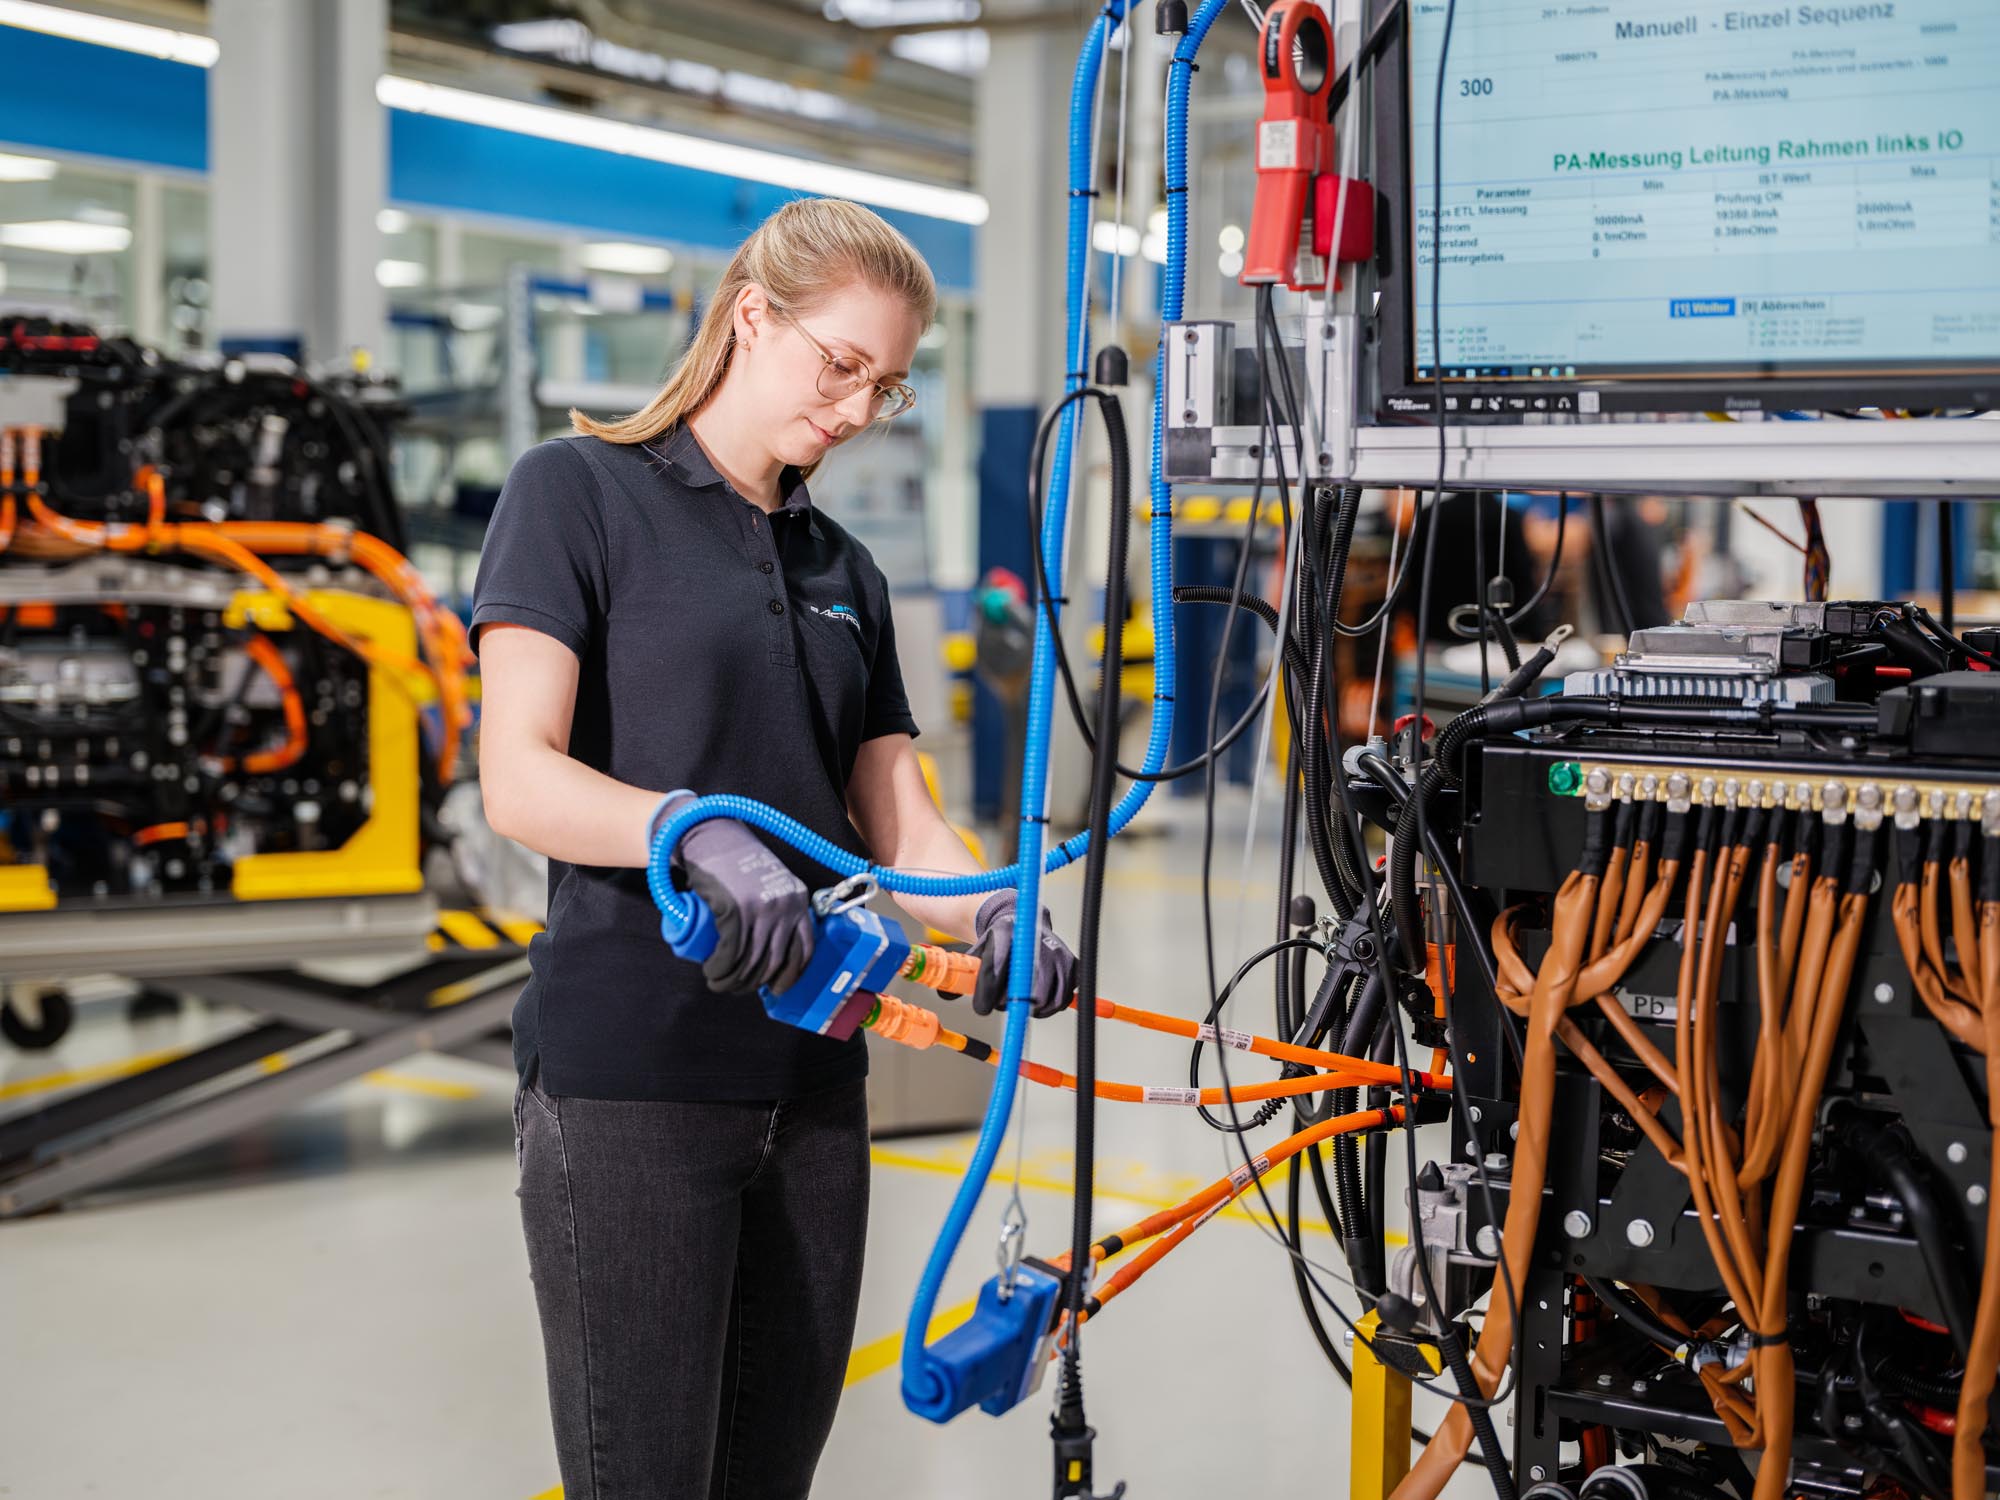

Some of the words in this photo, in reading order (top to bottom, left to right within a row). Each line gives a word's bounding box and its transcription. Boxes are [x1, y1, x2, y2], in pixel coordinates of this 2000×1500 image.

[1615, 17, 1698, 40] Manuell
[1725, 9, 1790, 31] Einzel
[1798, 2, 1895, 27] Sequenz
[1460, 78, 1494, 97] 300
[1553, 149, 1683, 172] PA-Messung
[1690, 140, 1771, 165] Leitung
[1777, 138, 1869, 160] Rahmen
[1876, 134, 1930, 153] links
[1938, 129, 1964, 150] IO
[1476, 187, 1531, 200] Parameter
[1765, 190, 1783, 202] OK
[1454, 206, 1476, 217] ETL
[1478, 205, 1528, 218] Messung
[1761, 300, 1826, 313] Abbrechen
[1633, 996, 1665, 1016] Pb
